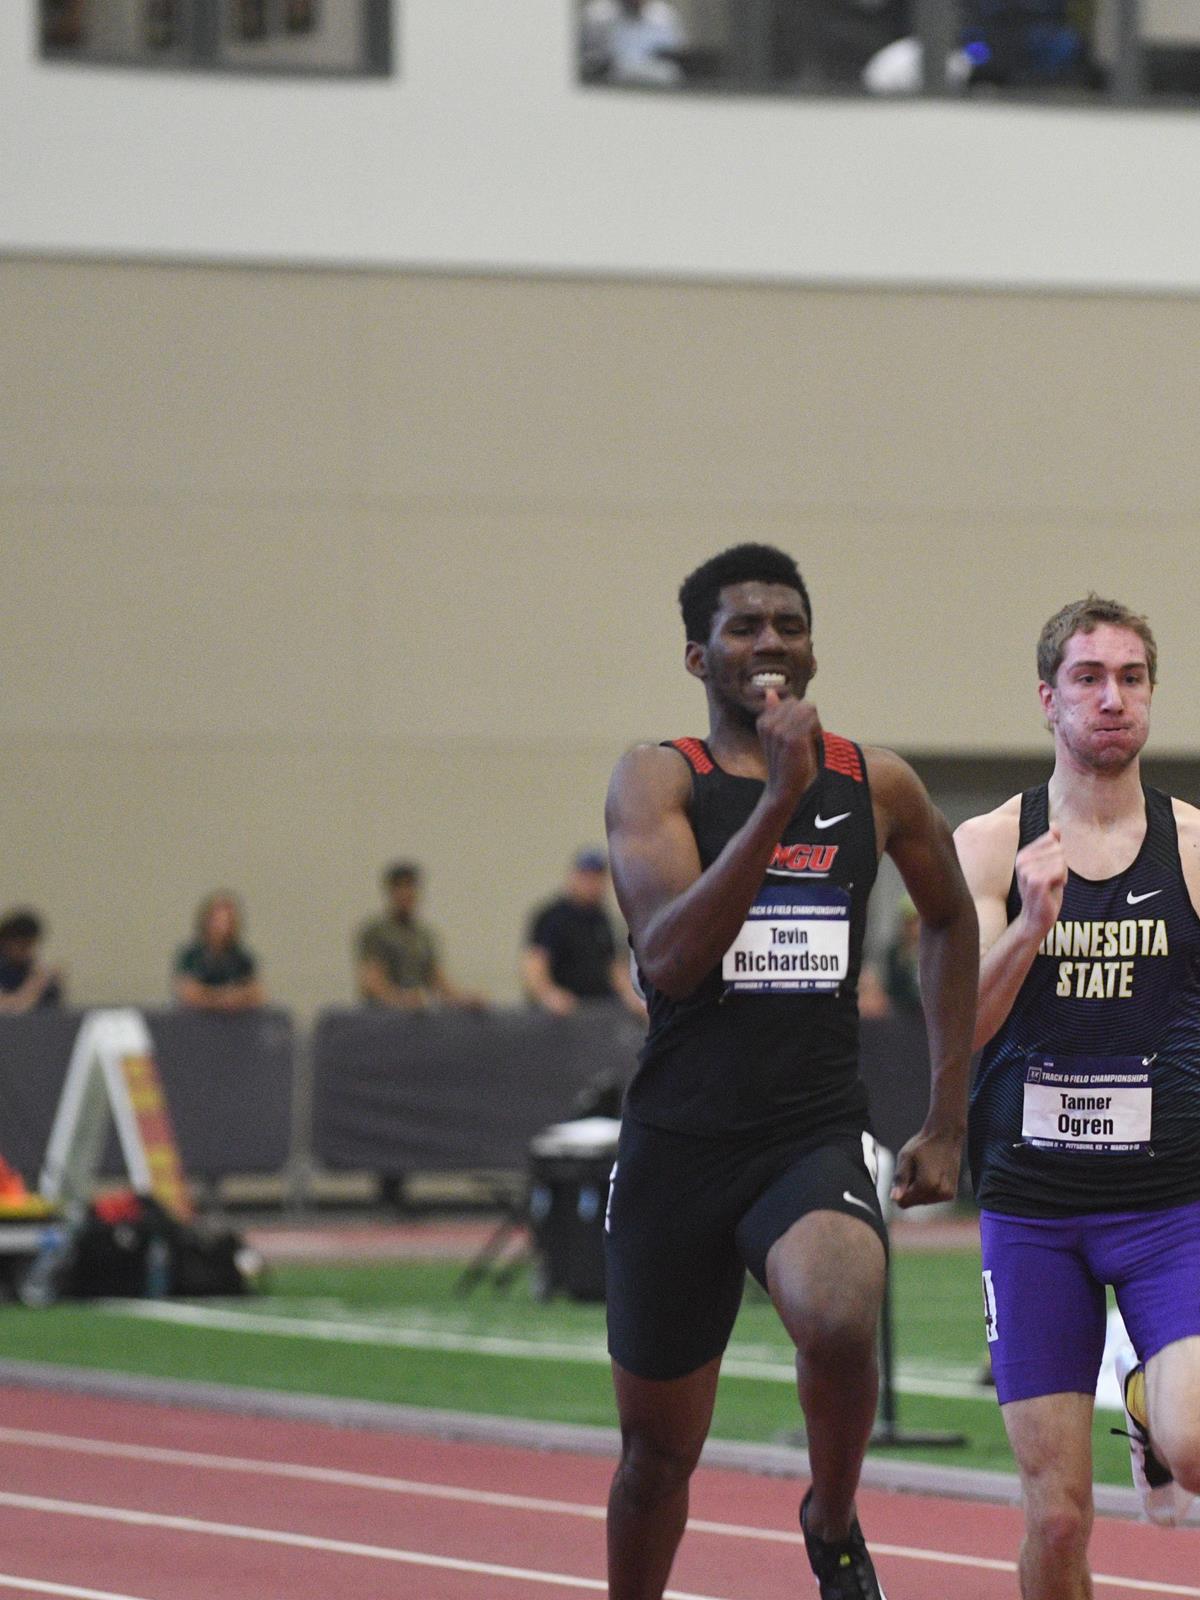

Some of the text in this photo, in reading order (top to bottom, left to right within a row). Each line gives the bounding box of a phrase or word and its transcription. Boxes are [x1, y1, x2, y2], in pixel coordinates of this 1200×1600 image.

[770, 927, 808, 944] Tevin
[1039, 919, 1169, 957] INNESOTA
[734, 951, 839, 972] Richardson
[1056, 961, 1134, 998] STATE
[1042, 1072, 1063, 1082] TRACK
[1069, 1075, 1089, 1083] FIELD
[1090, 1074, 1148, 1083] CHAMPIONSHIPS
[1060, 1094, 1112, 1110] Tanner
[1058, 1114, 1114, 1137] Ogren
